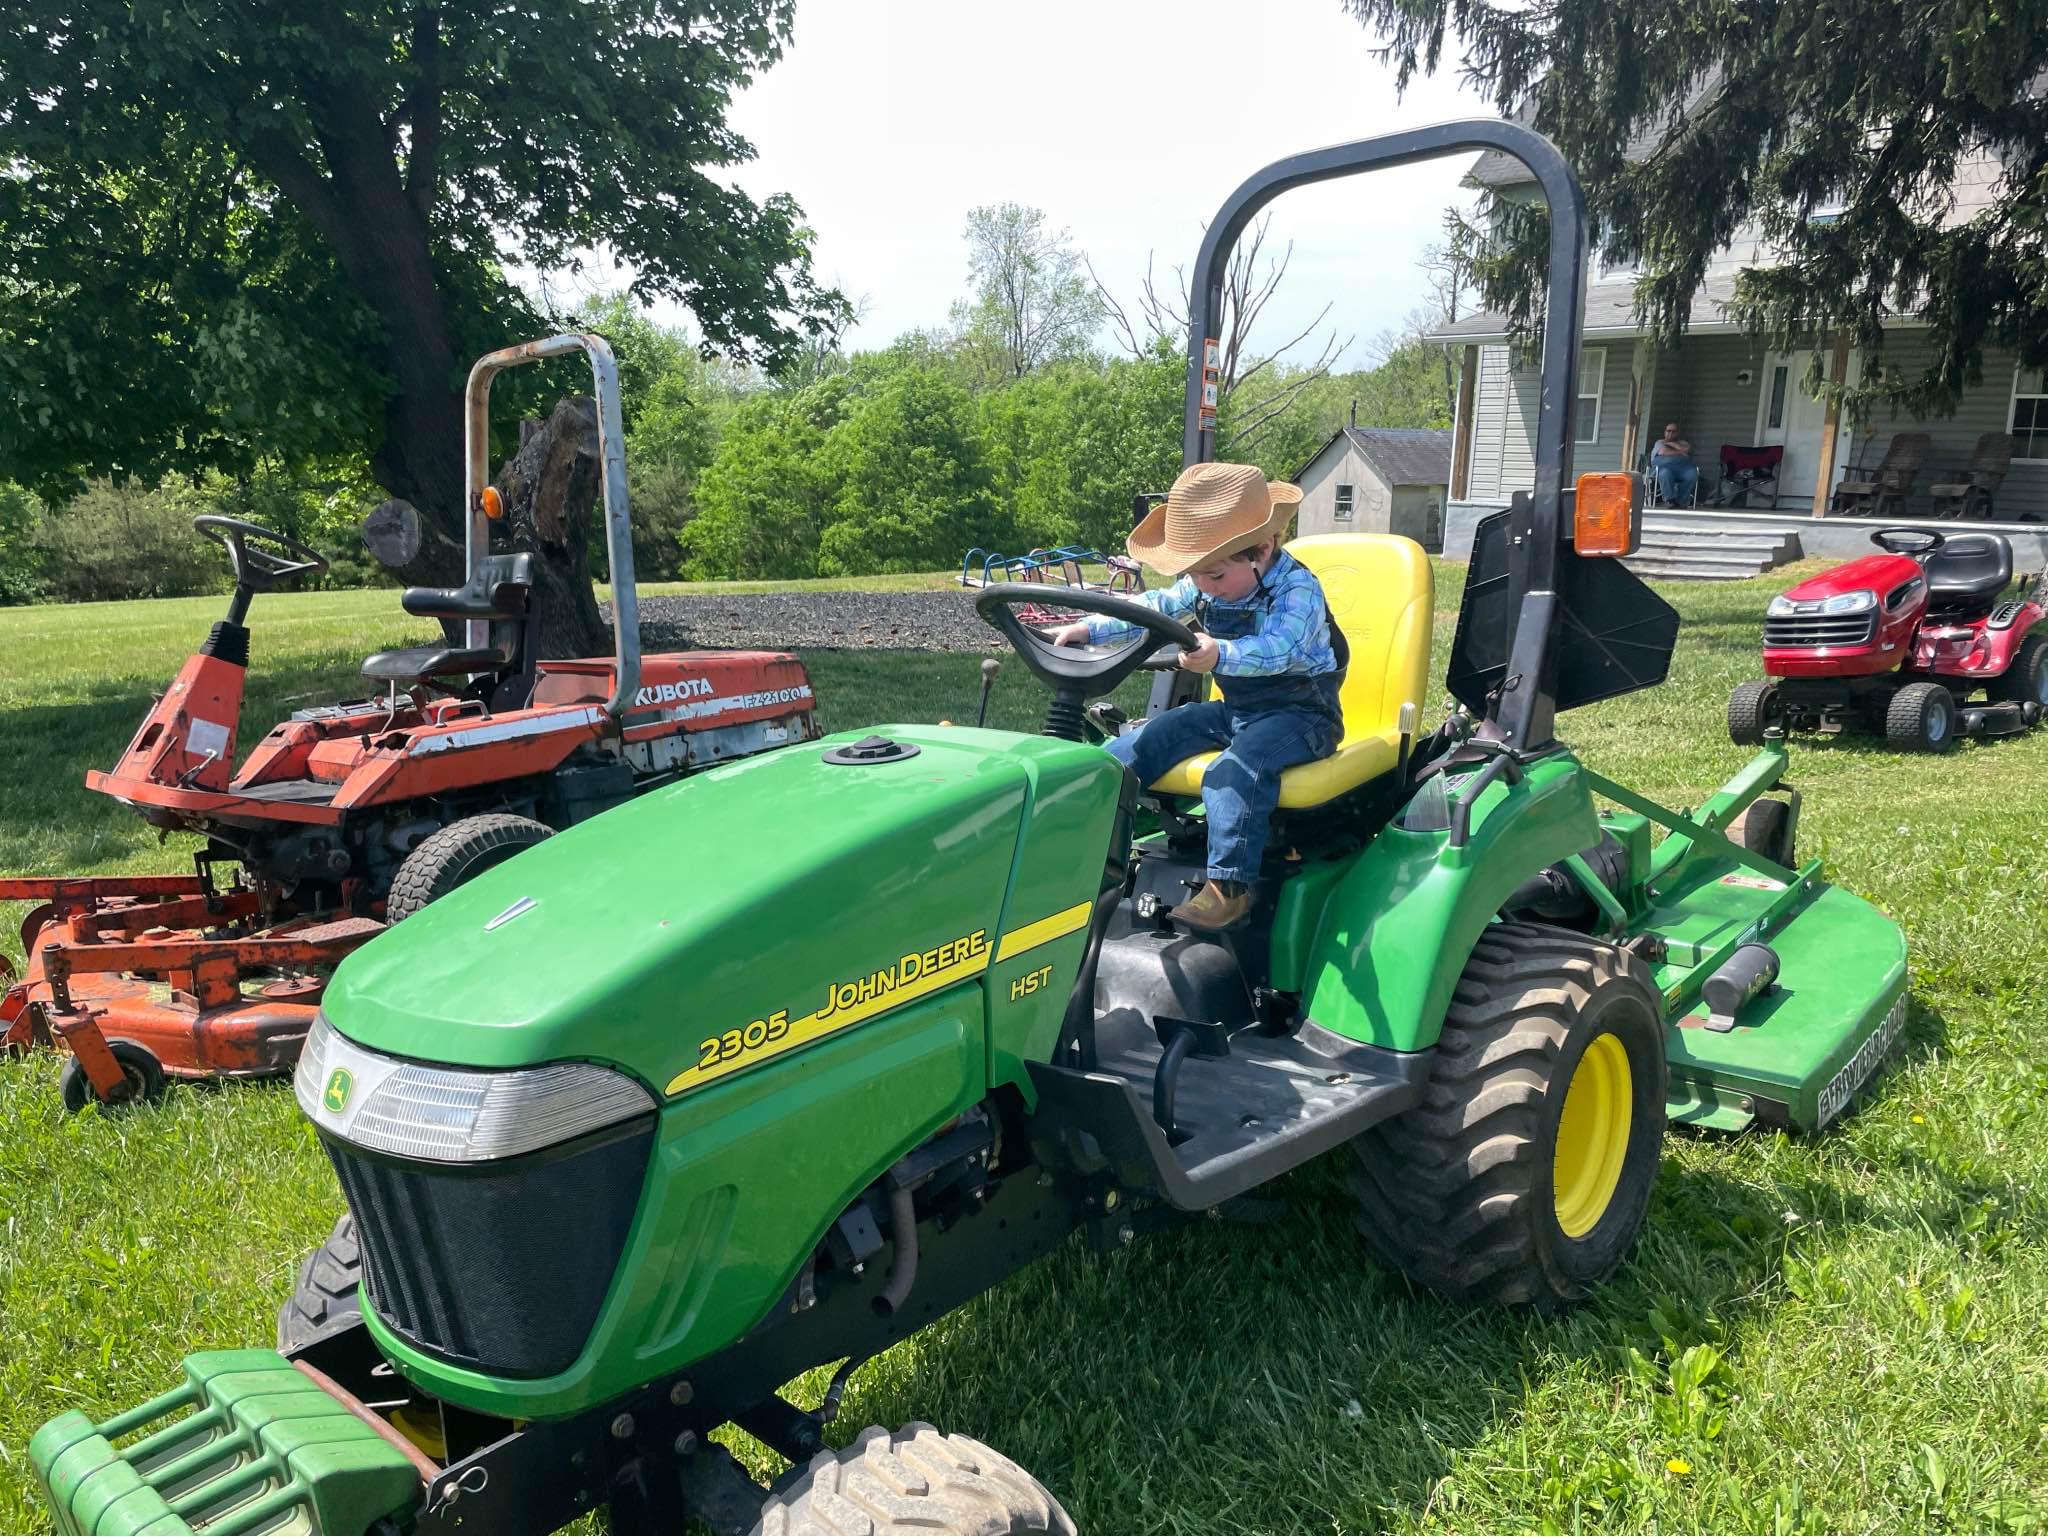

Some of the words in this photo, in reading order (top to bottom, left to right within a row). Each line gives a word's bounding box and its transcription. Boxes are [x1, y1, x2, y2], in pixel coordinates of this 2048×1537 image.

[634, 678, 714, 707] KUBOTA
[698, 1009, 790, 1071] 2305
[816, 965, 898, 1019] JOHN
[898, 929, 986, 987] DEERE
[1010, 964, 1053, 1001] HST
